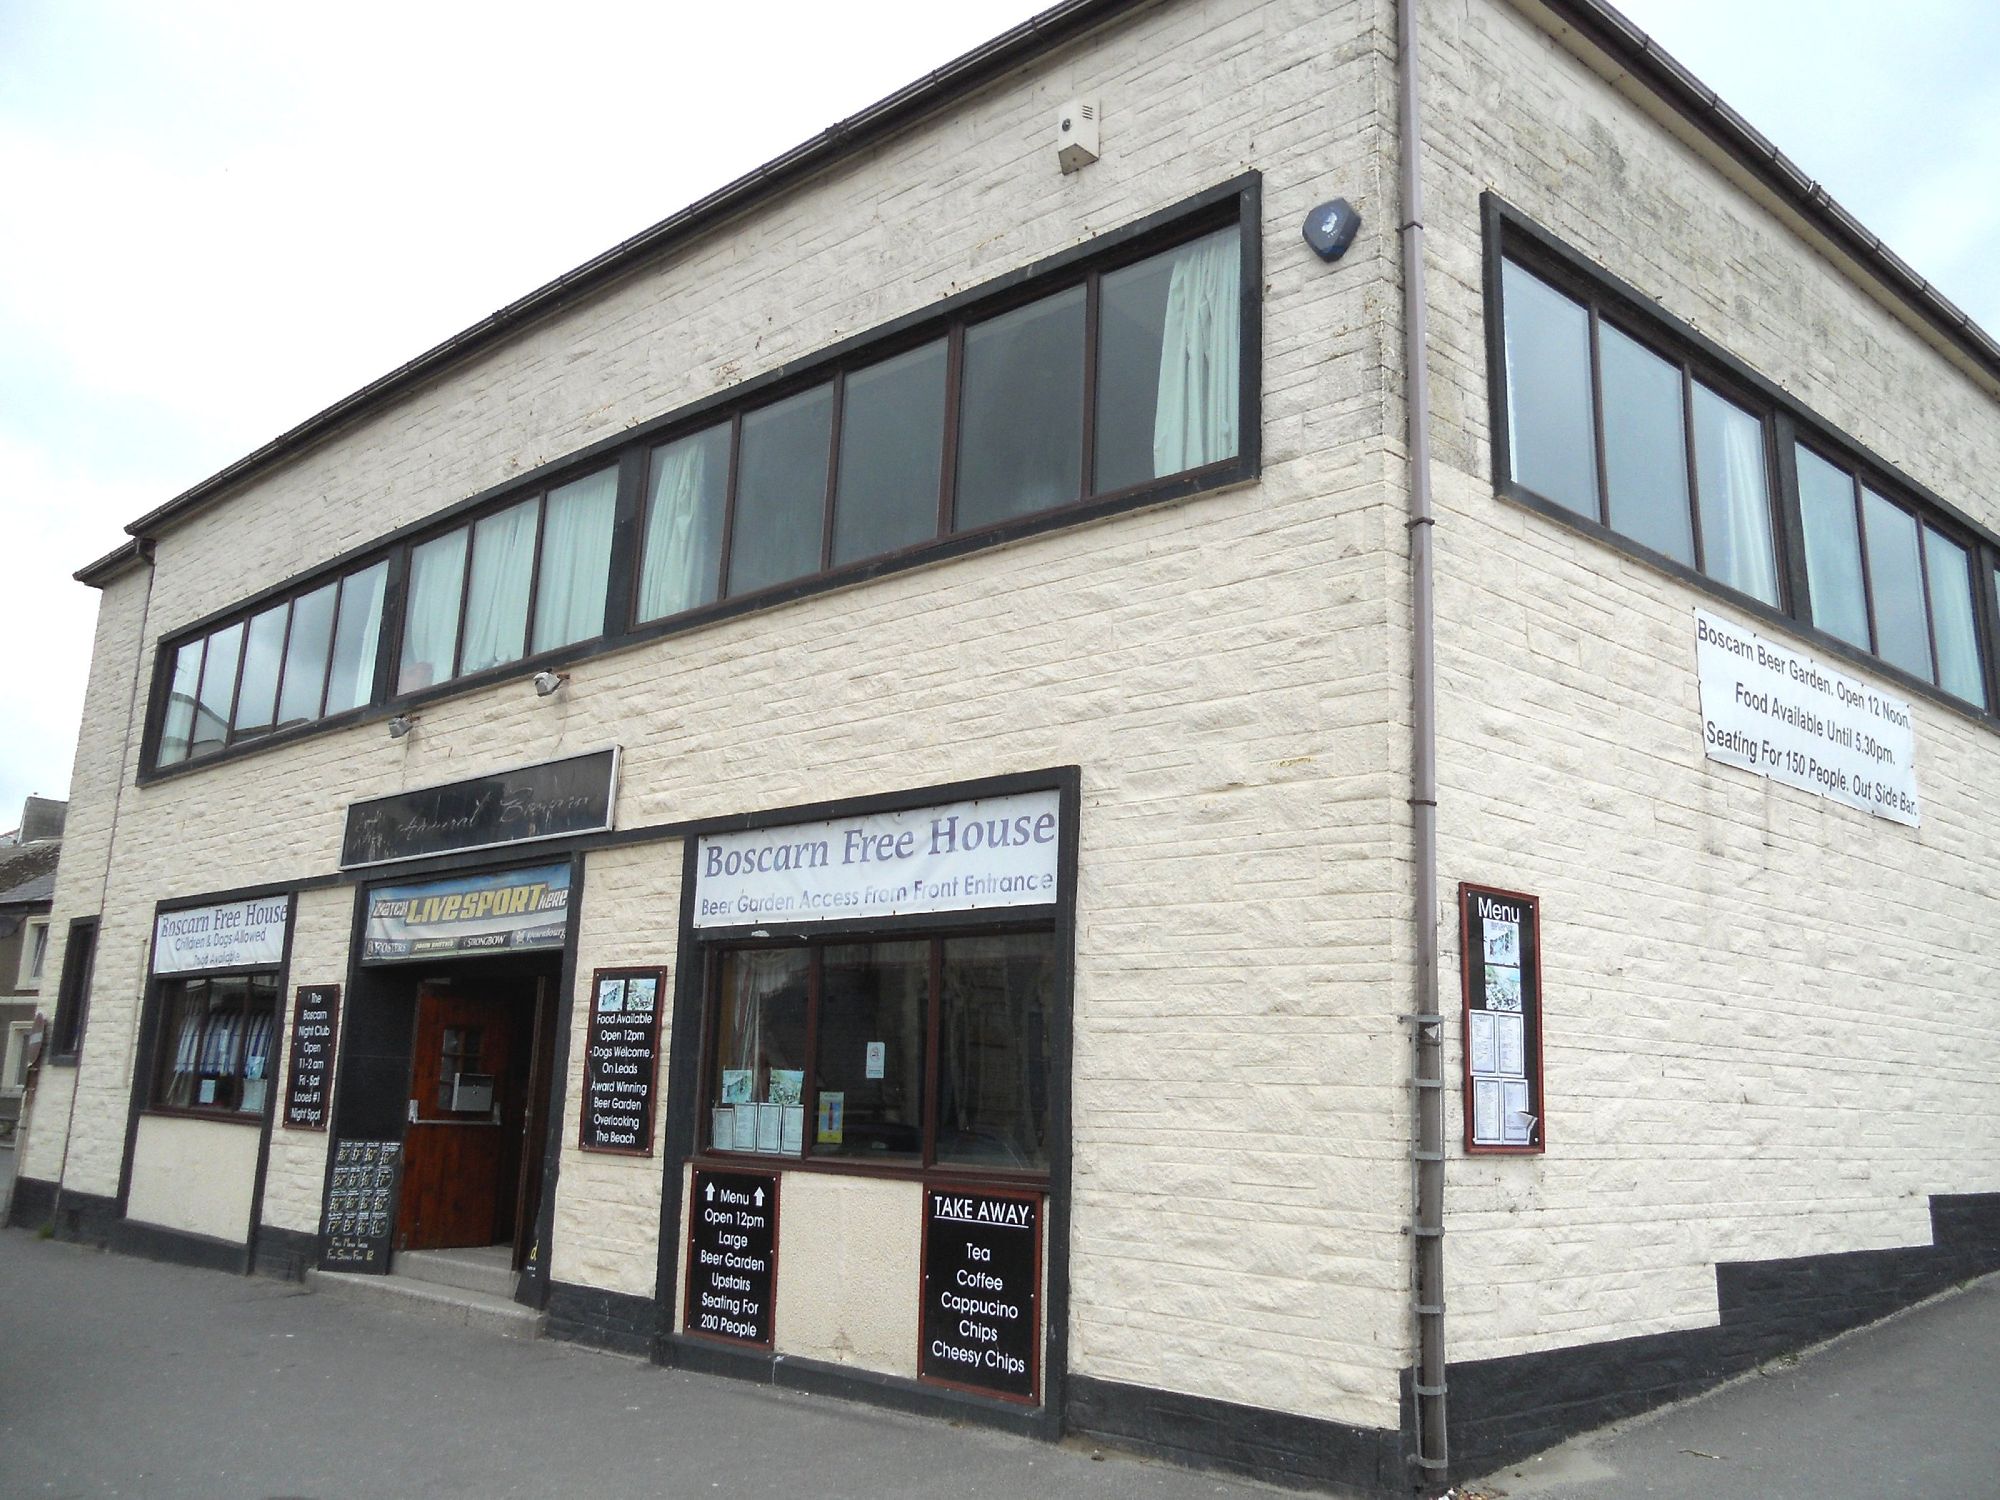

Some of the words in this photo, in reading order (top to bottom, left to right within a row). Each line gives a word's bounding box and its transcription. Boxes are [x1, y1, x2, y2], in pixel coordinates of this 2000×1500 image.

[1697, 618, 1753, 661] Boscarn
[1757, 645, 1785, 675] Beer
[1789, 660, 1833, 696] Garden.
[1837, 681, 1864, 711] Open
[1868, 693, 1879, 717] 12
[1883, 701, 1910, 729] Noon.
[1735, 682, 1768, 715] Food
[1772, 698, 1823, 737] Available
[1827, 720, 1852, 748] Until
[1706, 721, 1757, 764] Seating
[1762, 740, 1782, 767] For
[1786, 750, 1805, 776] 150
[1809, 759, 1849, 791] People.
[1853, 774, 1871, 800] Out
[1875, 785, 1899, 807] Side
[1900, 793, 1917, 816] Bar.
[705, 839, 828, 878] Boscarn
[842, 829, 914, 864] Free
[927, 812, 1055, 855] House
[701, 896, 734, 916] Beer
[737, 890, 795, 913] Garden
[799, 889, 859, 909] Access
[865, 884, 907, 904] From
[914, 877, 958, 900] Front
[965, 872, 1053, 895] Entrance
[1477, 896, 1520, 923] Menu
[161, 915, 209, 937] Boscarn
[214, 908, 240, 930] Free
[245, 904, 288, 926] House
[175, 935, 205, 951] Children
[206, 936, 211, 947] &
[214, 933, 233, 949] Dogs
[234, 927, 267, 944] Allowed
[311, 992, 321, 1003] The
[303, 1010, 327, 1020] Boscarn
[597, 1014, 616, 1025] Food
[617, 1013, 653, 1025] Available
[299, 1026, 314, 1038] Night
[315, 1025, 330, 1036] Club
[601, 1030, 621, 1042] Open
[623, 1030, 645, 1042] 12pm
[304, 1042, 321, 1055] Open
[593, 1046, 612, 1059] Dogs
[614, 1045, 650, 1058] Welcome
[602, 1063, 614, 1074] On
[615, 1063, 638, 1074] Leads
[591, 1081, 614, 1092] Award
[616, 1081, 647, 1096] Winning
[594, 1098, 611, 1108] Beer
[612, 1098, 641, 1111] Garden
[291, 1108, 306, 1121] Night
[307, 1109, 321, 1122] Spot
[594, 1114, 640, 1130] Overlooking
[596, 1130, 609, 1143] The
[610, 1131, 635, 1144] Beach
[720, 1189, 749, 1206] Menu
[704, 1208, 732, 1226] Open
[736, 1212, 765, 1229] 12pm
[934, 1196, 973, 1219] TAKE
[977, 1200, 1029, 1225] AWAY
[719, 1231, 748, 1250] Large
[700, 1250, 723, 1266] Beer
[725, 1253, 765, 1272] Garden
[966, 1242, 991, 1262] Tea
[711, 1272, 751, 1292] Upstairs
[956, 1269, 1003, 1291] Coffee
[702, 1292, 740, 1314] Seating
[742, 1299, 759, 1315] For
[941, 1292, 1019, 1319] Cappucino
[700, 1314, 718, 1330] 200
[720, 1317, 757, 1338] People
[959, 1319, 998, 1342] Chips
[932, 1340, 982, 1368] Cheesy
[985, 1350, 1025, 1374] Chips
